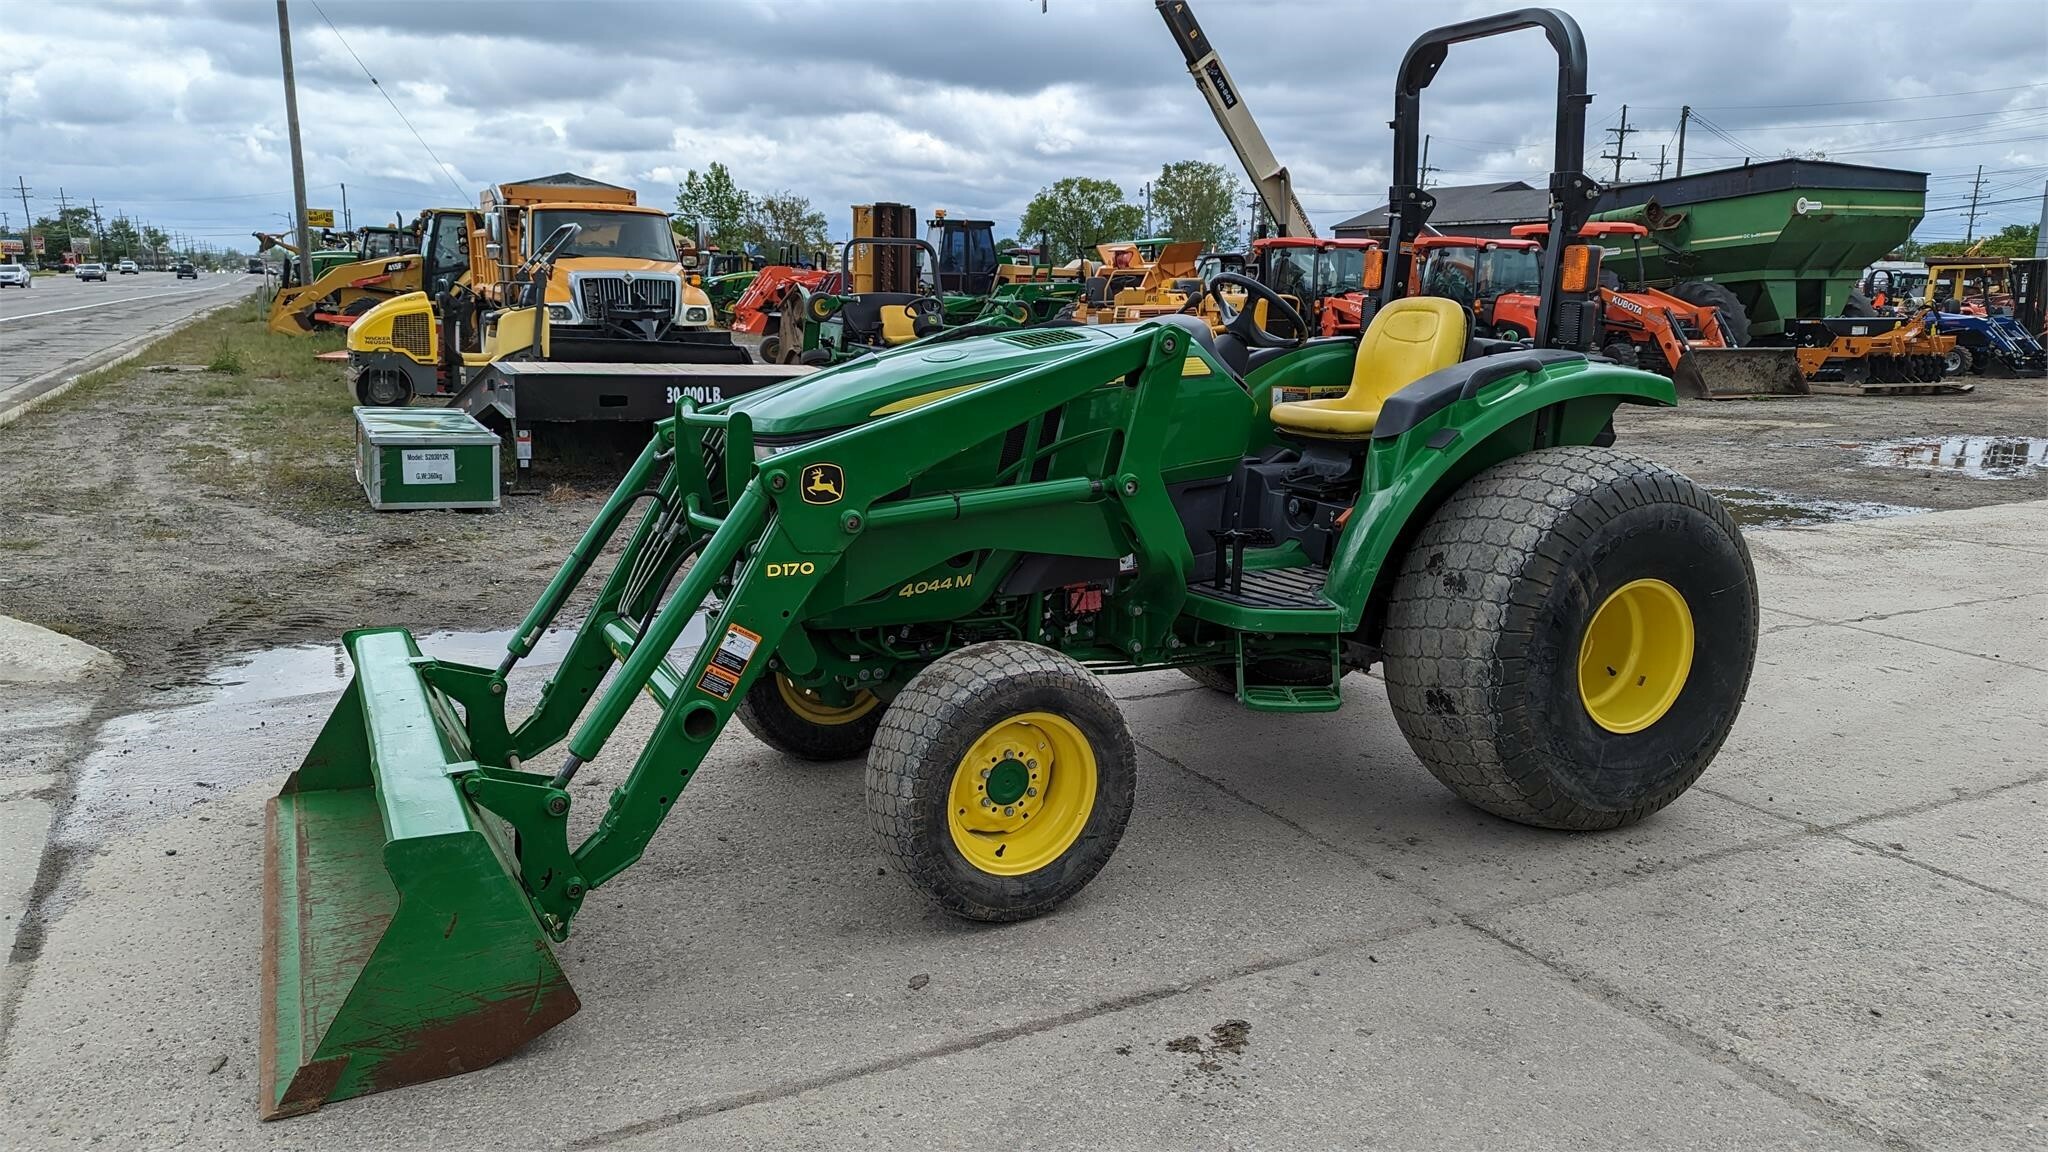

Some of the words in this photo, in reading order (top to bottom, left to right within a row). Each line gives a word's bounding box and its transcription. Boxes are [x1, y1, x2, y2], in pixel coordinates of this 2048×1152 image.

[1611, 295, 1642, 315] KUBOTA
[406, 453, 424, 461] Model:
[767, 561, 815, 577] D170
[898, 577, 953, 598] 4044
[954, 573, 973, 588] M
[737, 629, 759, 641] WARNING
[714, 669, 736, 682] WARNING
